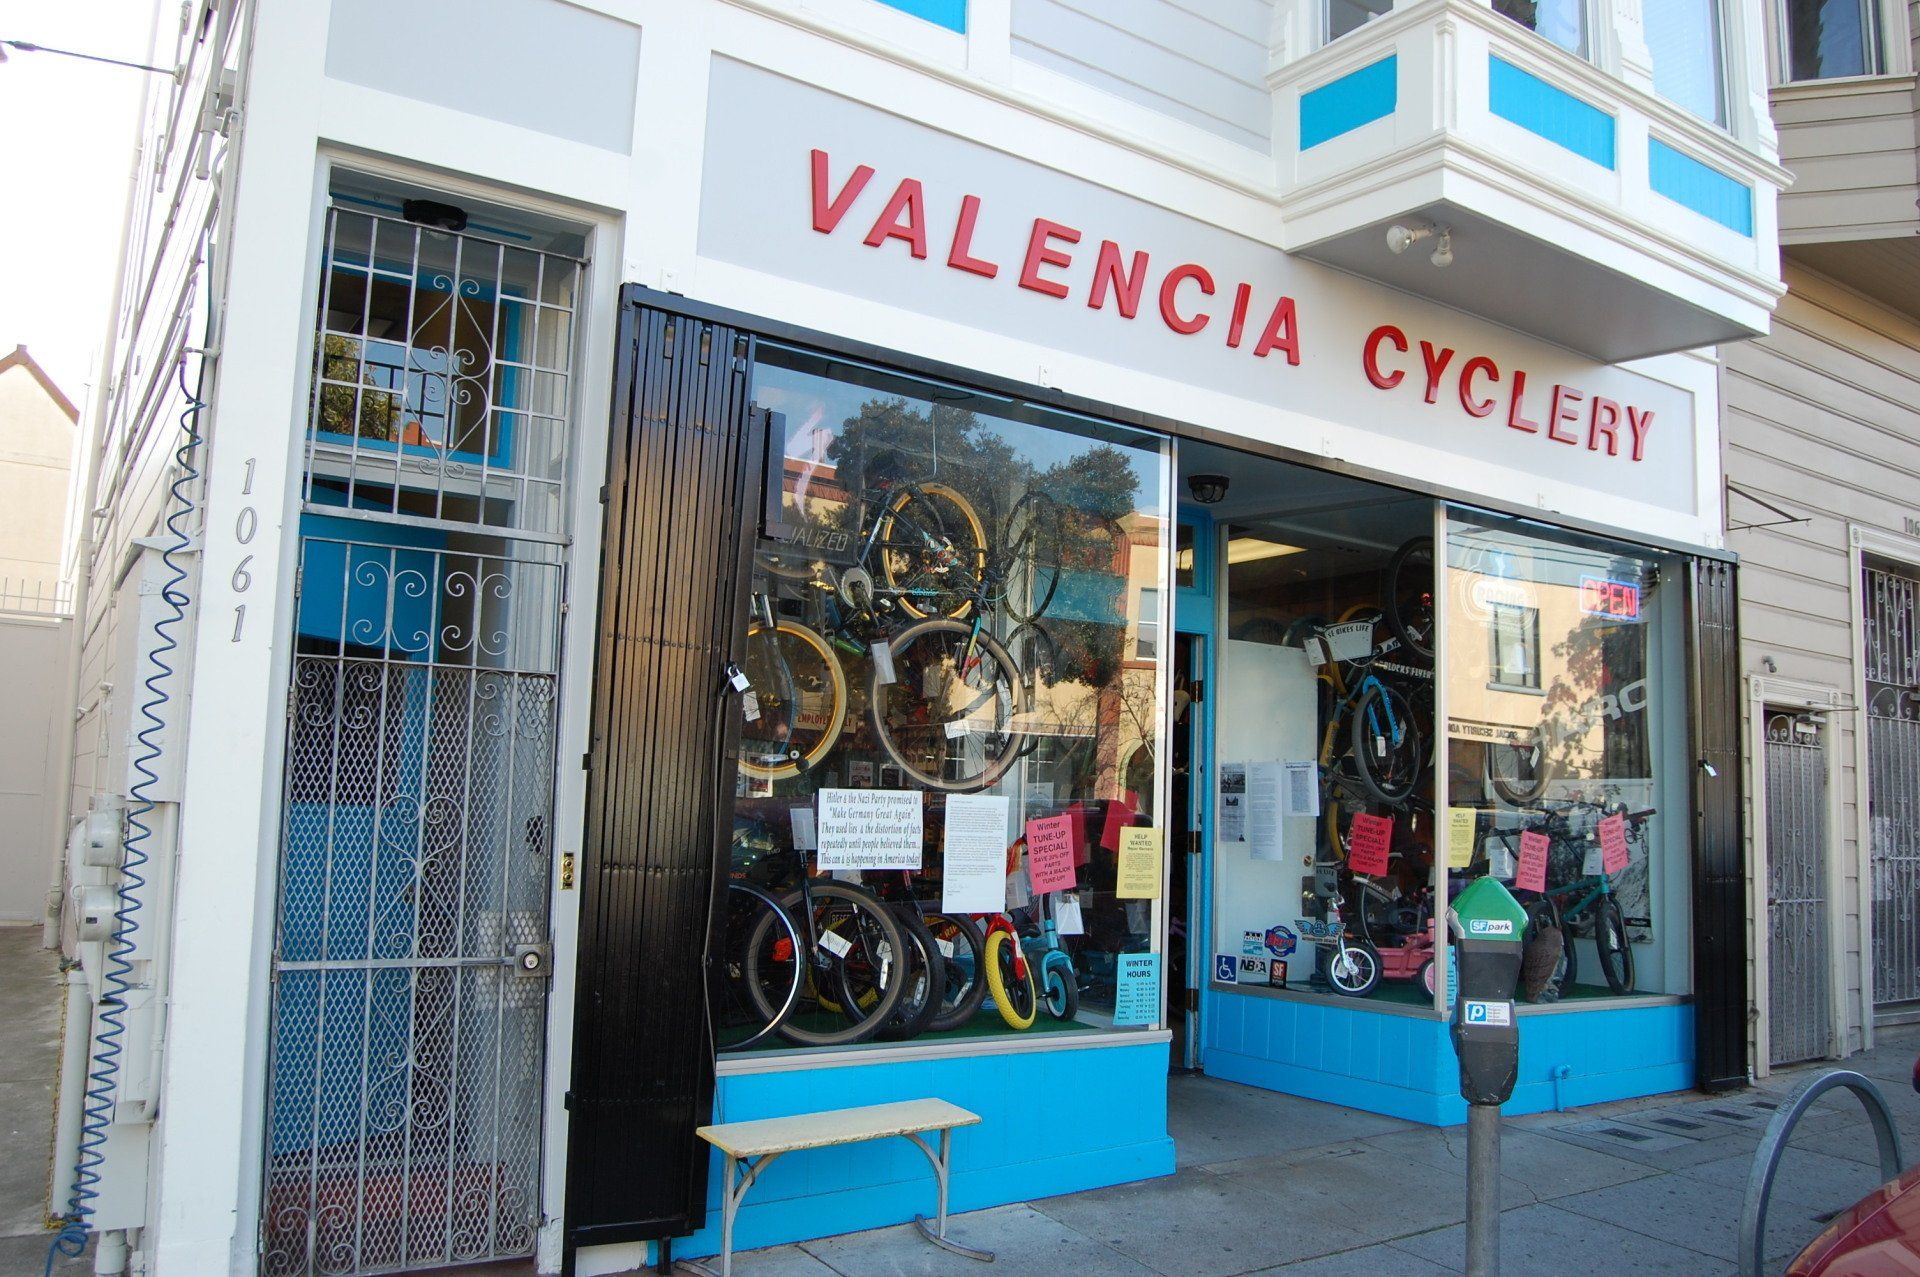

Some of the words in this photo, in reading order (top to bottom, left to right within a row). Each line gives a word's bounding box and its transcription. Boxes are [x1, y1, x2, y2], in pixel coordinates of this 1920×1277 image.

[811, 148, 1300, 366] VALENCIA
[1363, 325, 1655, 461] CYCLERY
[231, 457, 258, 643] 1061
[1583, 579, 1636, 617] OPEN
[826, 792, 842, 804] Hitler
[848, 793, 857, 804] the
[857, 793, 870, 804] Nazi
[871, 793, 886, 807] Party
[887, 794, 913, 807] promised
[913, 796, 918, 804] to
[848, 808, 873, 822] Germany
[876, 808, 892, 819] Great
[821, 822, 835, 837] They
[836, 822, 847, 833] used
[848, 822, 857, 833] lies
[865, 822, 873, 834] the
[875, 823, 902, 834] distortion
[909, 823, 922, 838] facts
[1037, 822, 1060, 831] Winter
[820, 837, 847, 852] repeatedly
[848, 837, 861, 849] until
[862, 838, 879, 852] people
[880, 837, 902, 849] believed
[1033, 831, 1066, 843] TUNE-UP
[1033, 841, 1068, 855] SPECIAL!
[821, 853, 831, 864] This
[832, 856, 840, 864] can
[851, 853, 877, 867] happening
[885, 853, 905, 864] America
